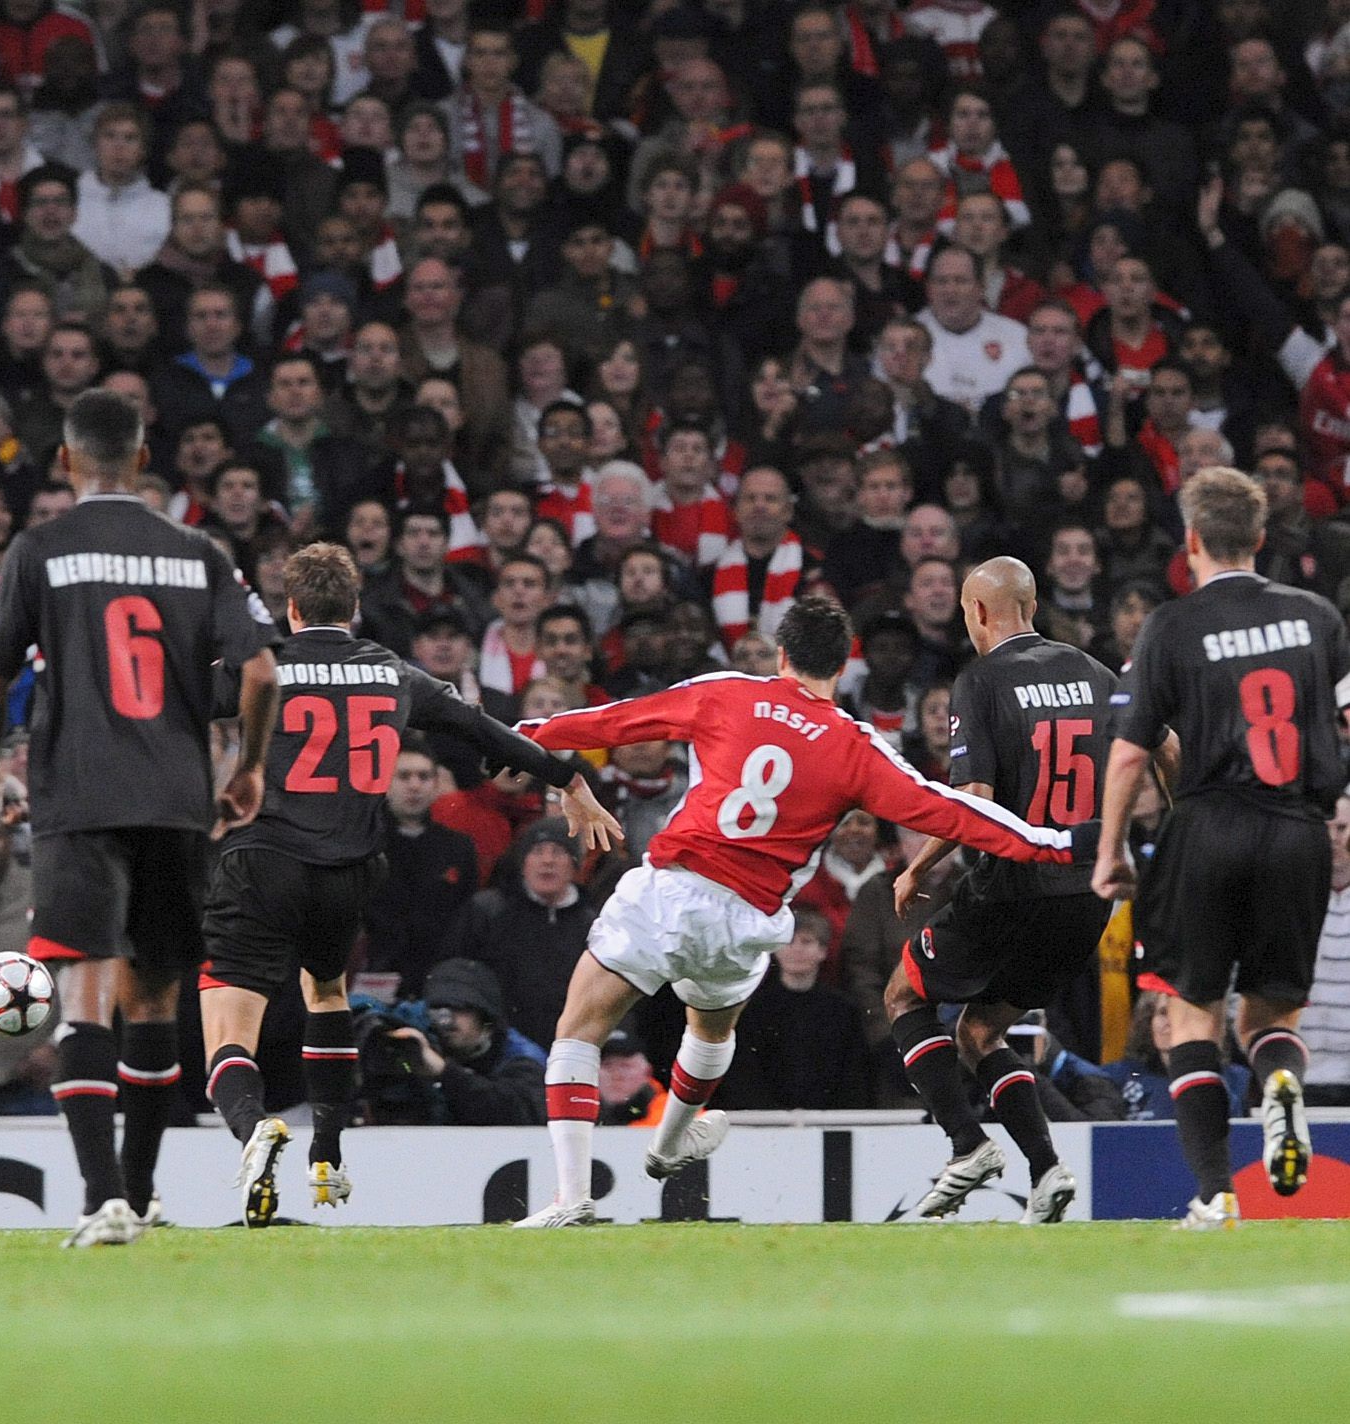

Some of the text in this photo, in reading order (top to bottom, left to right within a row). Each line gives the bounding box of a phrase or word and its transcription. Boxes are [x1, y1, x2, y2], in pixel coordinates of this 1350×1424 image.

[104, 595, 165, 720] 6
[275, 663, 400, 687] MOISANDER
[1202, 619, 1312, 662] SCHAARS
[753, 701, 829, 741] nasri
[1013, 681, 1094, 709] POULSEN
[1239, 667, 1300, 787] 8
[282, 695, 401, 794] 25
[716, 744, 794, 840] 8
[1026, 719, 1095, 826] 15
